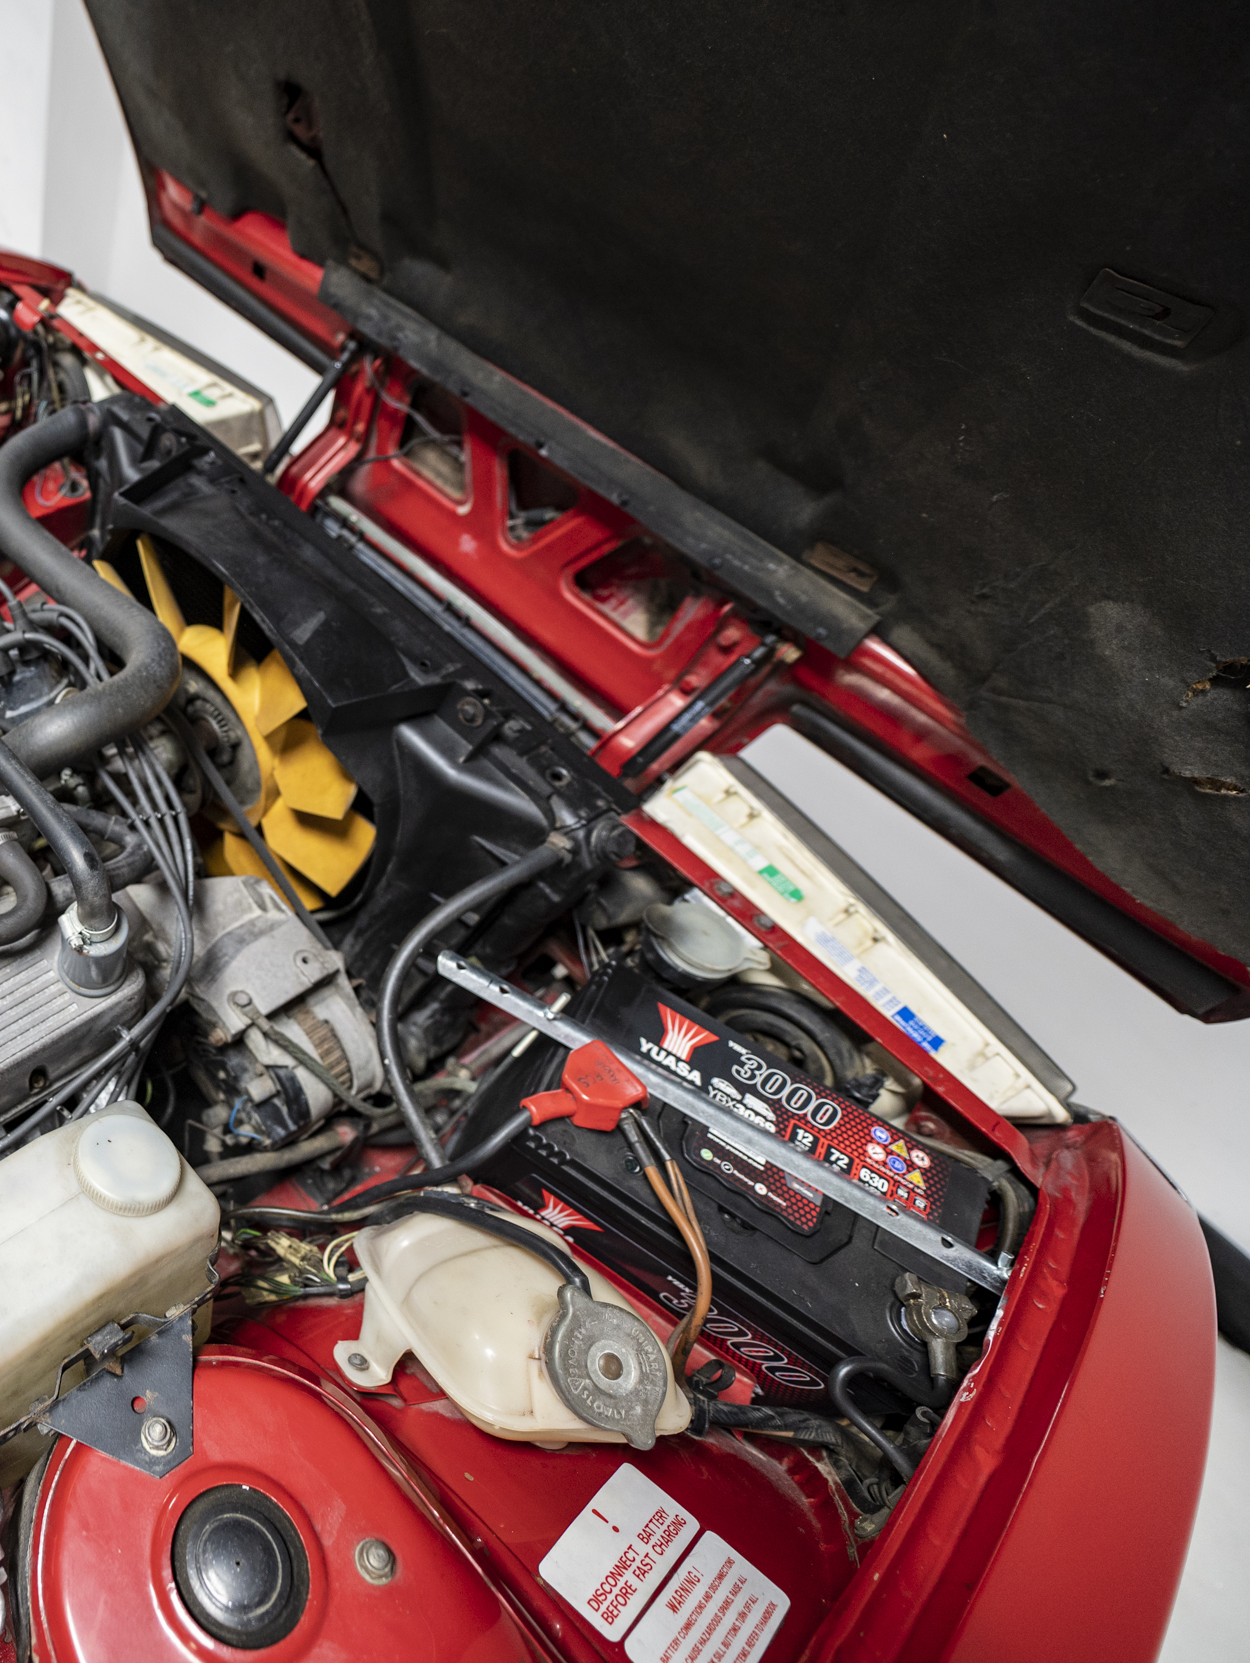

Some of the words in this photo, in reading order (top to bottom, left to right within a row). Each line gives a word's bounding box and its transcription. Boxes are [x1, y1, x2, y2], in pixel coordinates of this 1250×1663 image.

[640, 1037, 702, 1086] YUASA
[731, 1054, 842, 1129] 3000
[796, 1128, 814, 1147] 12
[830, 1148, 849, 1169] 72
[859, 1167, 889, 1192] 630
[631, 1327, 662, 1378] UNIPART
[660, 1292, 825, 1389] 3000
[582, 1390, 626, 1420] SLOWLY
[587, 1544, 640, 1613] DISCONNECT
[637, 1506, 670, 1545] BATTERY
[601, 1580, 638, 1626] BEFORE
[632, 1552, 657, 1582] FAST
[651, 1514, 687, 1556] CHARGING
[660, 1636, 682, 1663] BATTERY
[678, 1600, 707, 1640] CONNECTIONS
[702, 1590, 713, 1604] AND
[708, 1556, 735, 1594] DISCONNECTIONS
[665, 1570, 701, 1614] WARNING
[685, 1643, 702, 1663] CAUSE
[697, 1612, 723, 1648] HAZARDOUS
[717, 1595, 735, 1617] SPARKS
[729, 1581, 743, 1598] RAISE
[737, 1574, 748, 1586] ALL
[713, 1647, 726, 1662] SILL
[721, 1622, 741, 1650] BUTTONS
[735, 1609, 748, 1626] TURN
[743, 1600, 753, 1614] OFF
[748, 1593, 759, 1606] ALL
[733, 1646, 750, 1663] TEMS
[745, 1630, 760, 1650] REFER
[754, 1623, 764, 1634] TO
[760, 1600, 778, 1628] HANDBOOK
